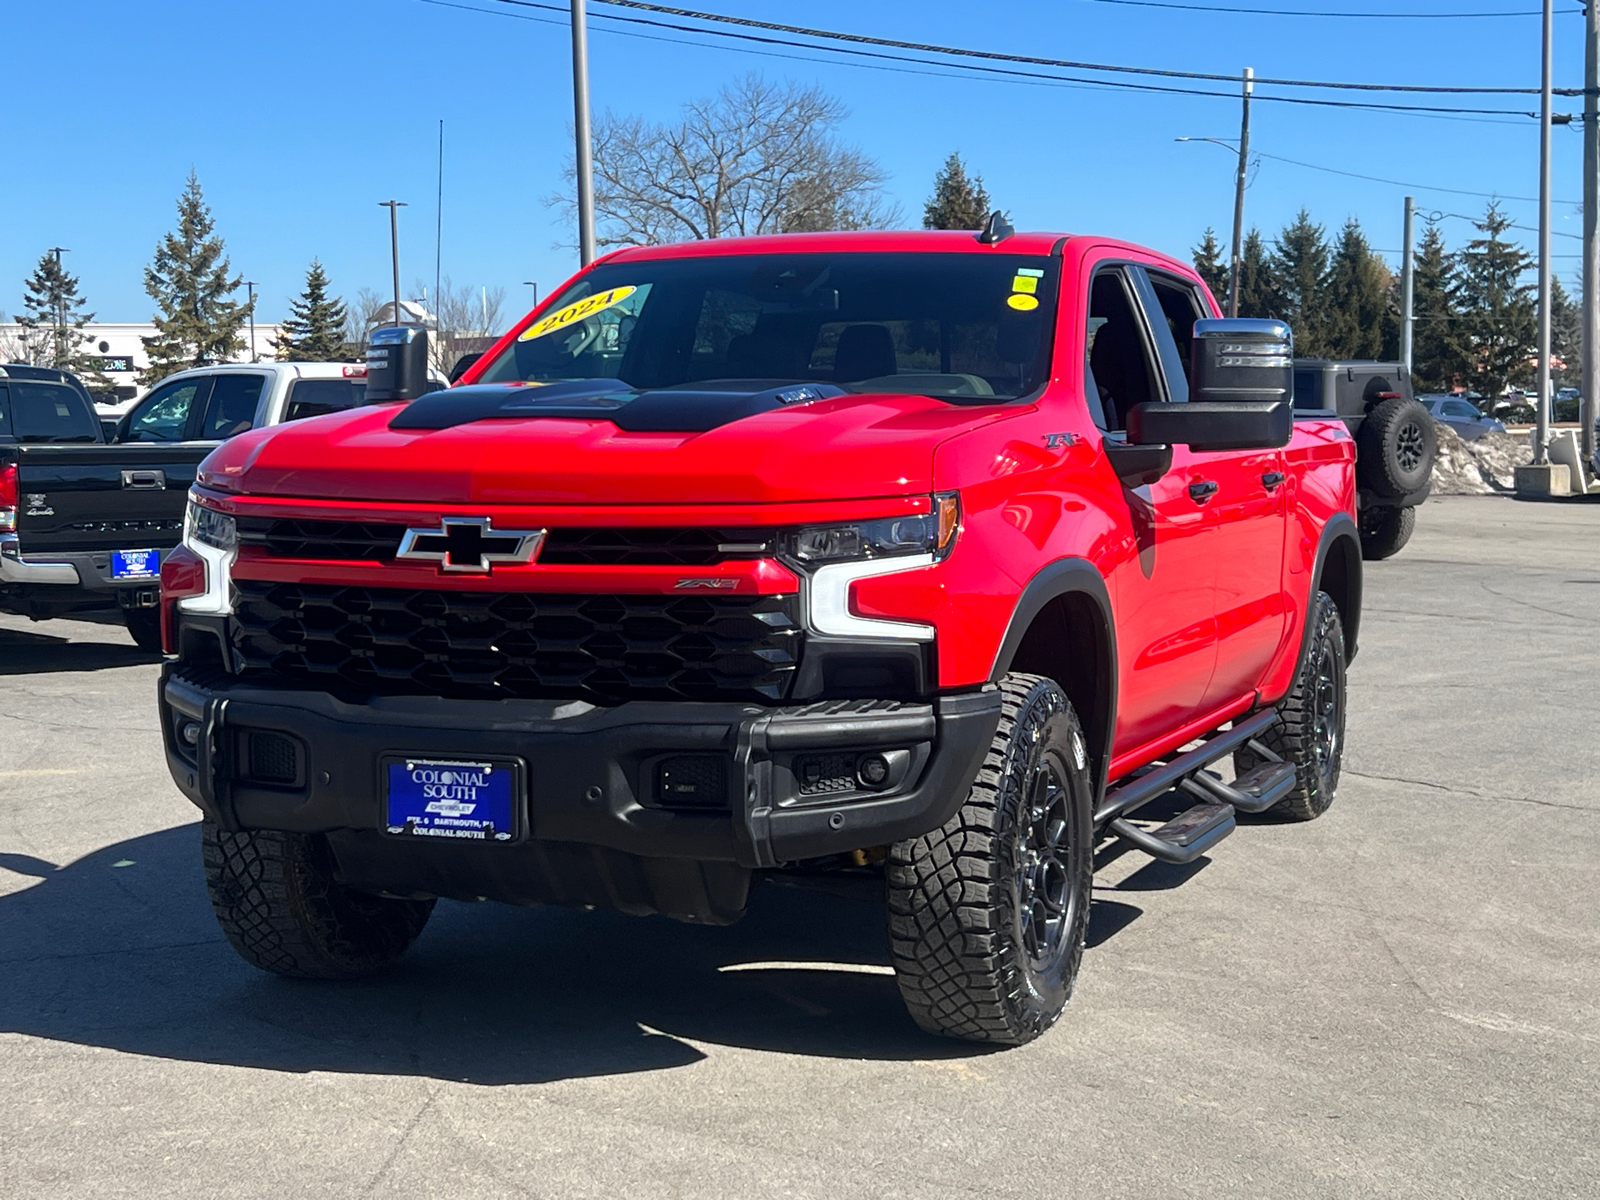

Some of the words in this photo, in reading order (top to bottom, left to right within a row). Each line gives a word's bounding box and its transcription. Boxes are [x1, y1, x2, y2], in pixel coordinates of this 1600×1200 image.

[540, 291, 616, 334] 2024
[412, 770, 489, 786] COLONIAL
[423, 785, 477, 799] SOUTH
[429, 803, 471, 812] CHEVROLET
[423, 817, 430, 825] 6
[434, 818, 482, 828] DARTMOUTH,
[412, 827, 455, 838] COLONIAL
[456, 830, 486, 839] SOUTH
